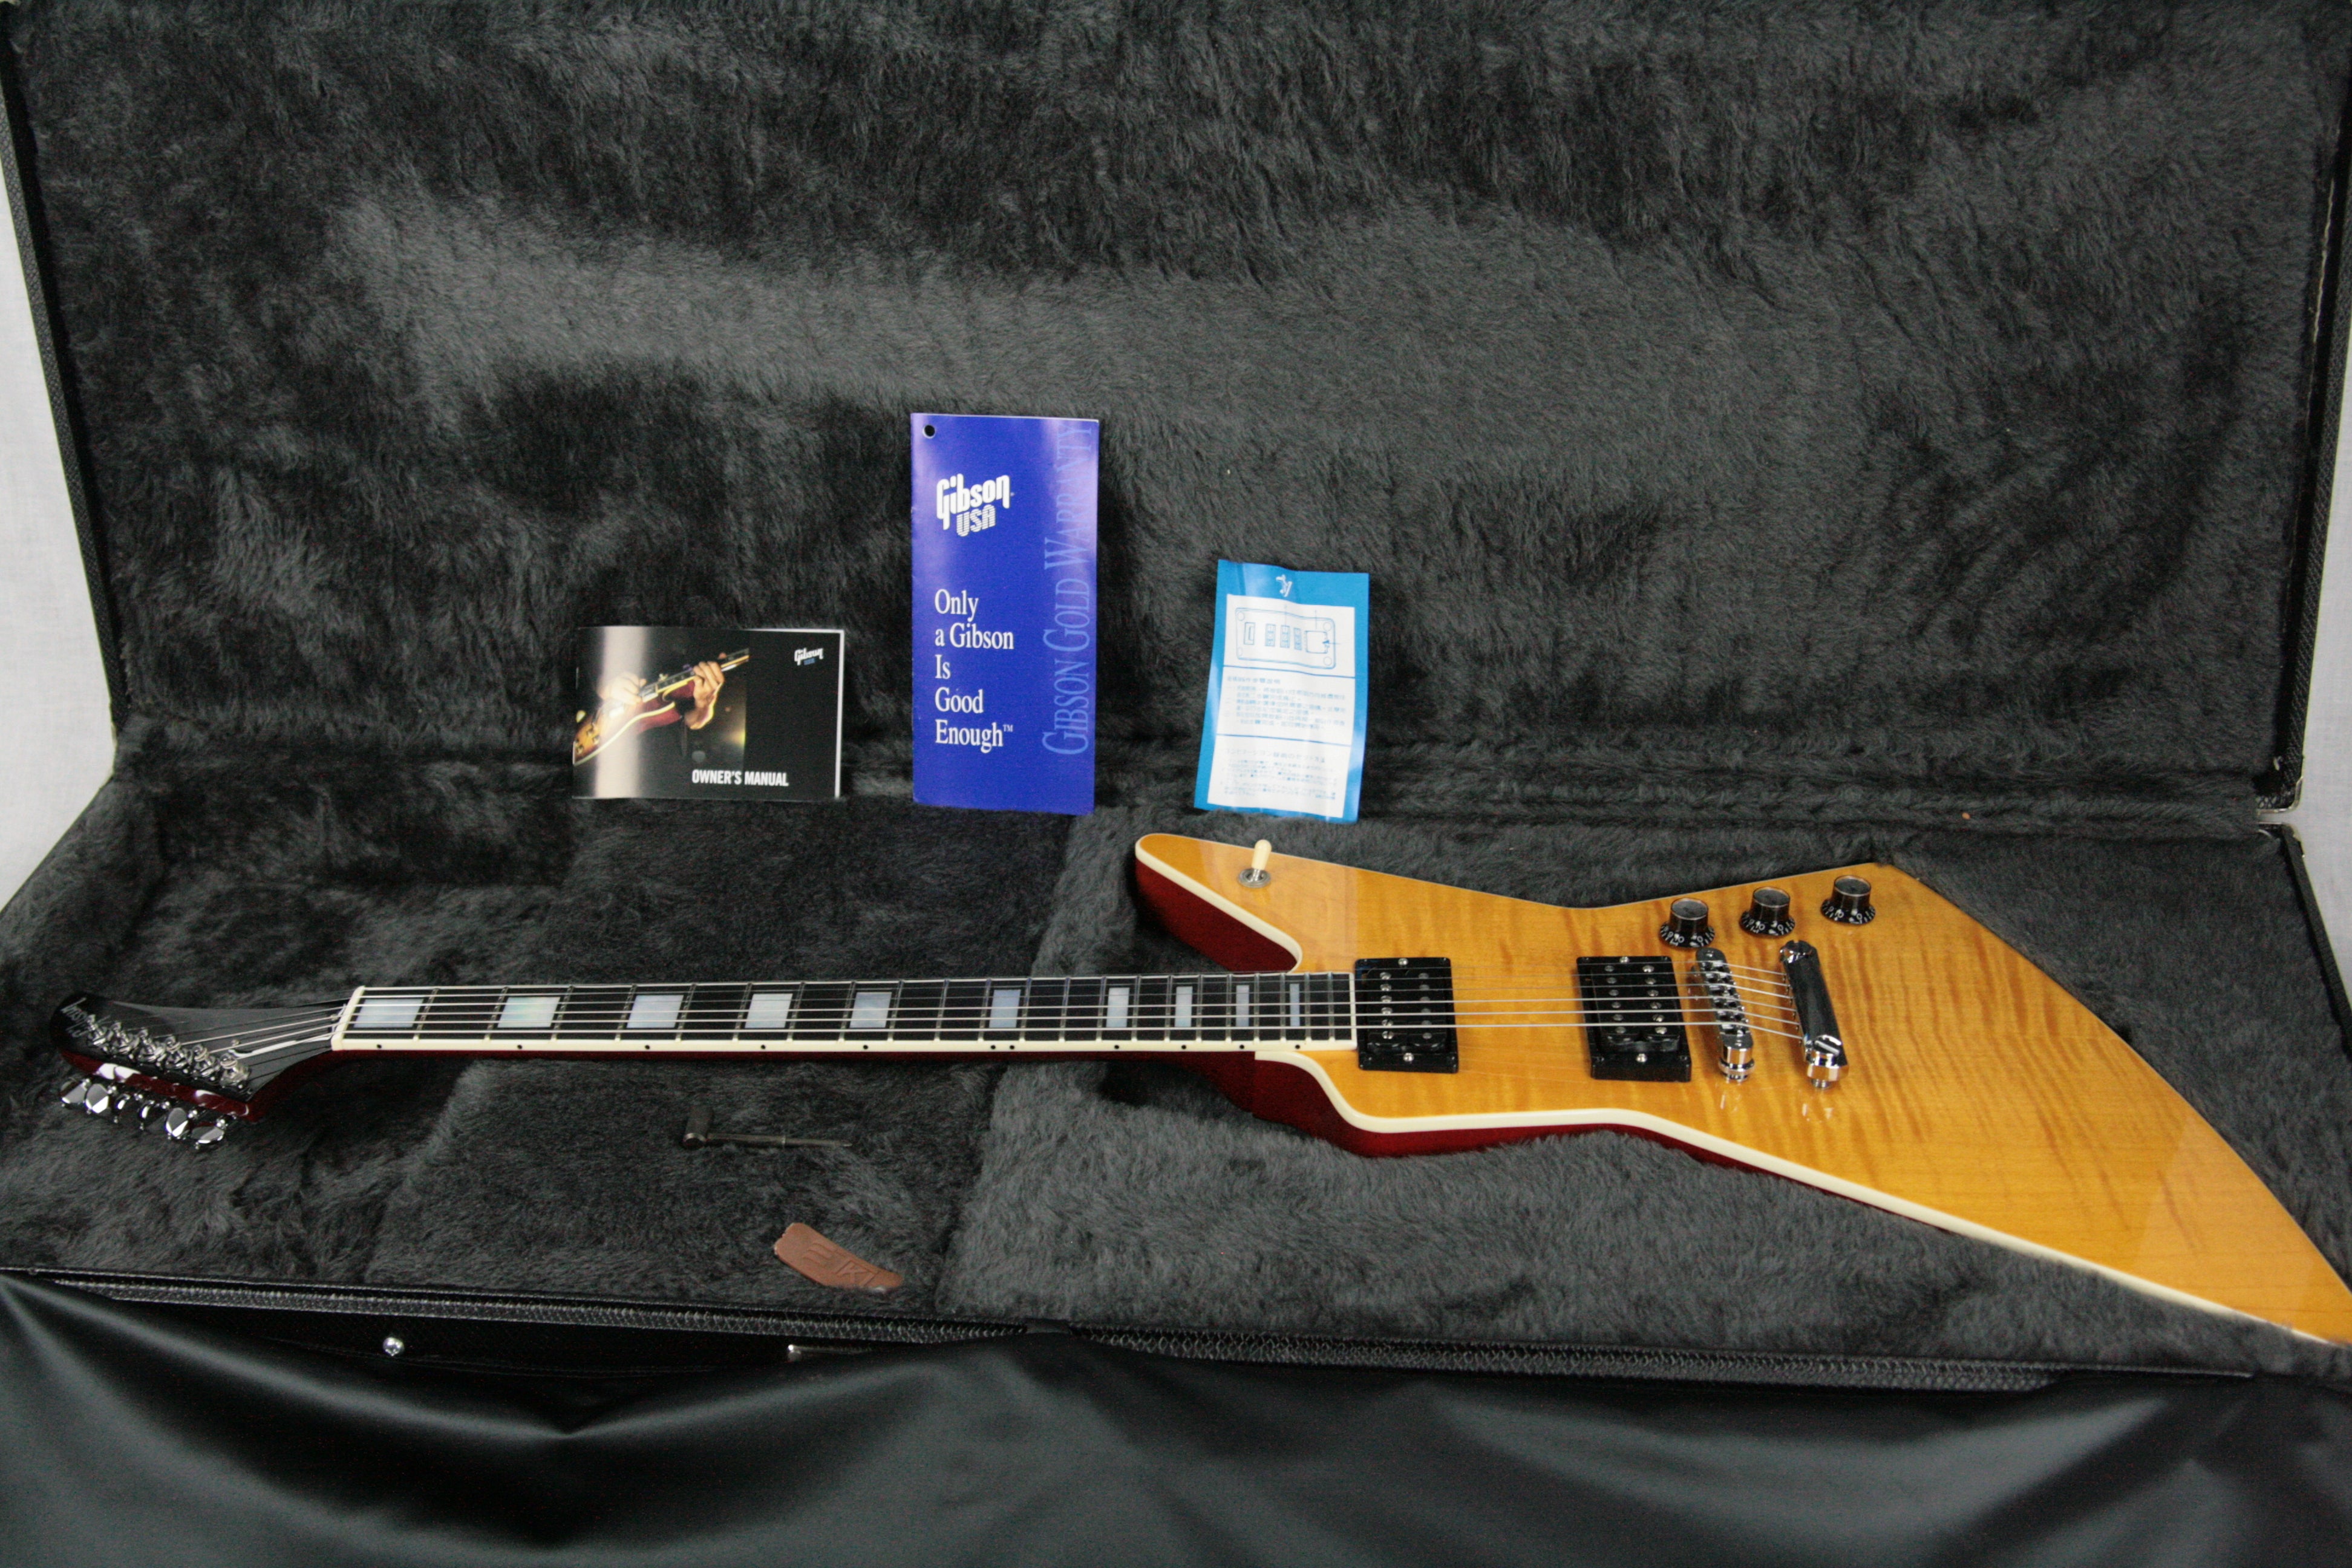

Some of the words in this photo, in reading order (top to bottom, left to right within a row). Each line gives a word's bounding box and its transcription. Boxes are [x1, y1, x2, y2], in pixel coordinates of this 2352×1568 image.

[936, 473, 1010, 531] Gibson
[1044, 424, 1091, 570] WARRANTY
[956, 504, 996, 537] USA
[935, 589, 979, 622] Only
[1043, 578, 1089, 652] GOLD
[935, 629, 946, 647] a
[950, 622, 1014, 650] Gibson
[935, 654, 951, 680] Is
[935, 687, 984, 714] Good
[1042, 660, 1089, 755] GIBSON
[692, 769, 742, 785] OWNER'S
[744, 771, 789, 786] MANUAL
